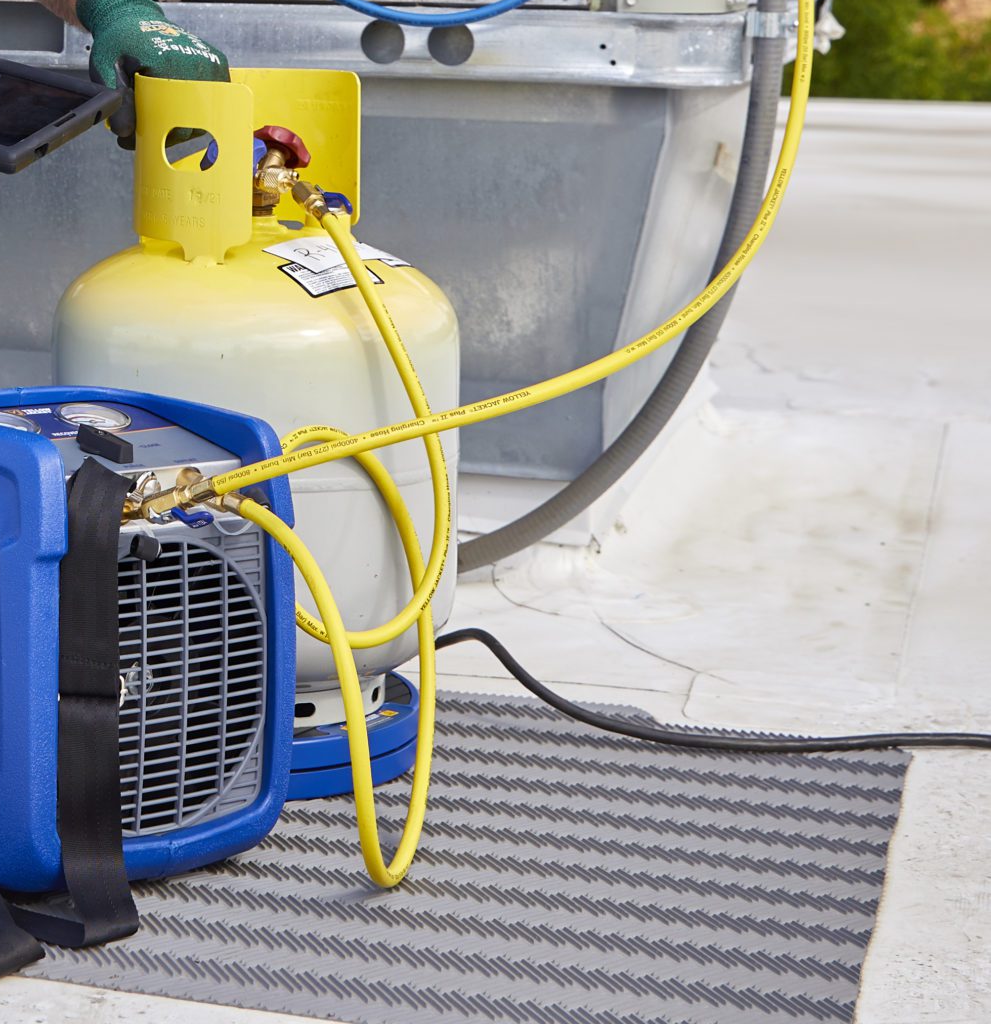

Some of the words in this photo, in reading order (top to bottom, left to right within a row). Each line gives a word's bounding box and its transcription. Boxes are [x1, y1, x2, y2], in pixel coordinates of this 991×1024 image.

[502, 390, 531, 404] YELLOW
[448, 409, 466, 418] Plus
[390, 419, 426, 433] Charging
[369, 428, 389, 439] Hose
[329, 437, 359, 452] 4000psi
[297, 449, 313, 461] Bar)
[313, 445, 329, 457] (275
[260, 461, 280, 471] burst
[228, 469, 251, 480] 800psi
[420, 587, 437, 612] YELLOW
